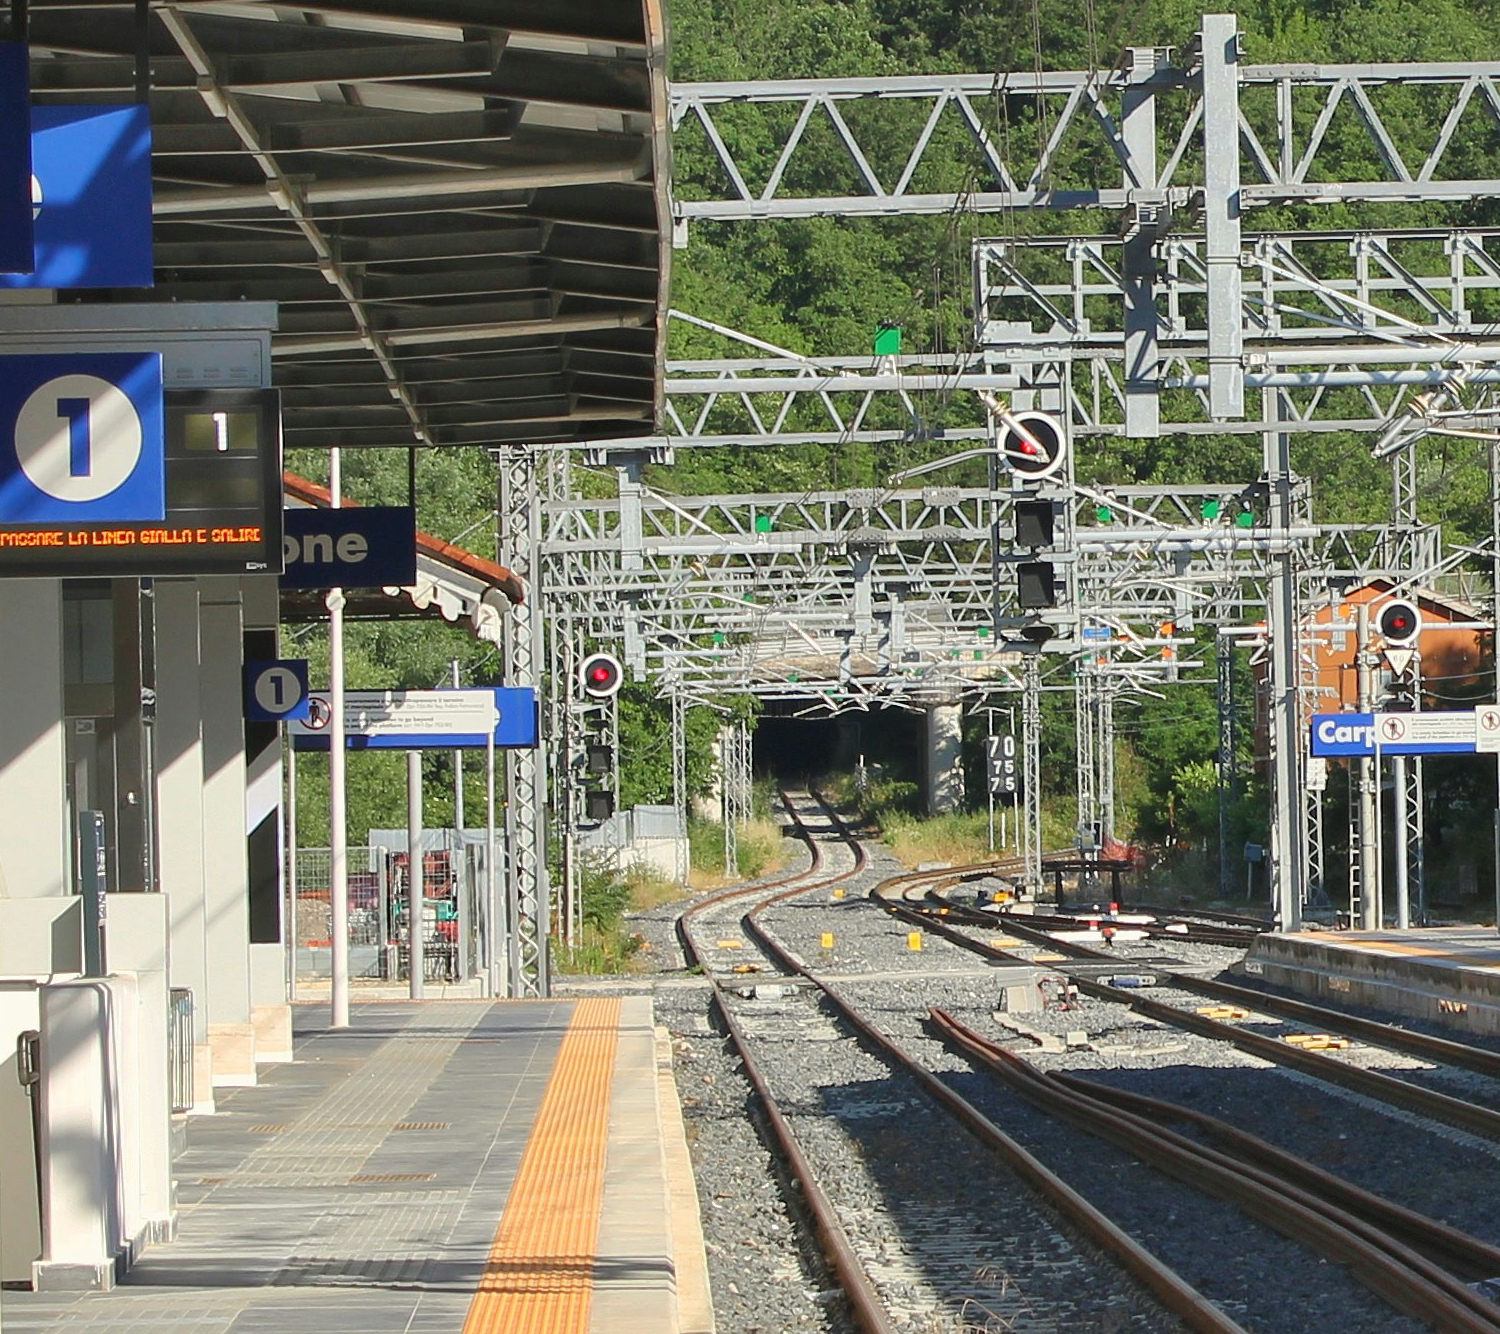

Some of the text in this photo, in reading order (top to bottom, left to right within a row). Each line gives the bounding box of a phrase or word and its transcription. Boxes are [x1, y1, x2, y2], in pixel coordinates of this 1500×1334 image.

[57, 398, 91, 477] 1
[212, 411, 229, 452] 1
[69, 530, 88, 546] LA
[92, 530, 136, 546] LINEA
[140, 528, 194, 545] GIALLA
[211, 527, 261, 543] SALIRE
[270, 676, 283, 705] 1
[988, 735, 1015, 758] 70
[992, 759, 1014, 775] 75
[990, 776, 1016, 792] 75
